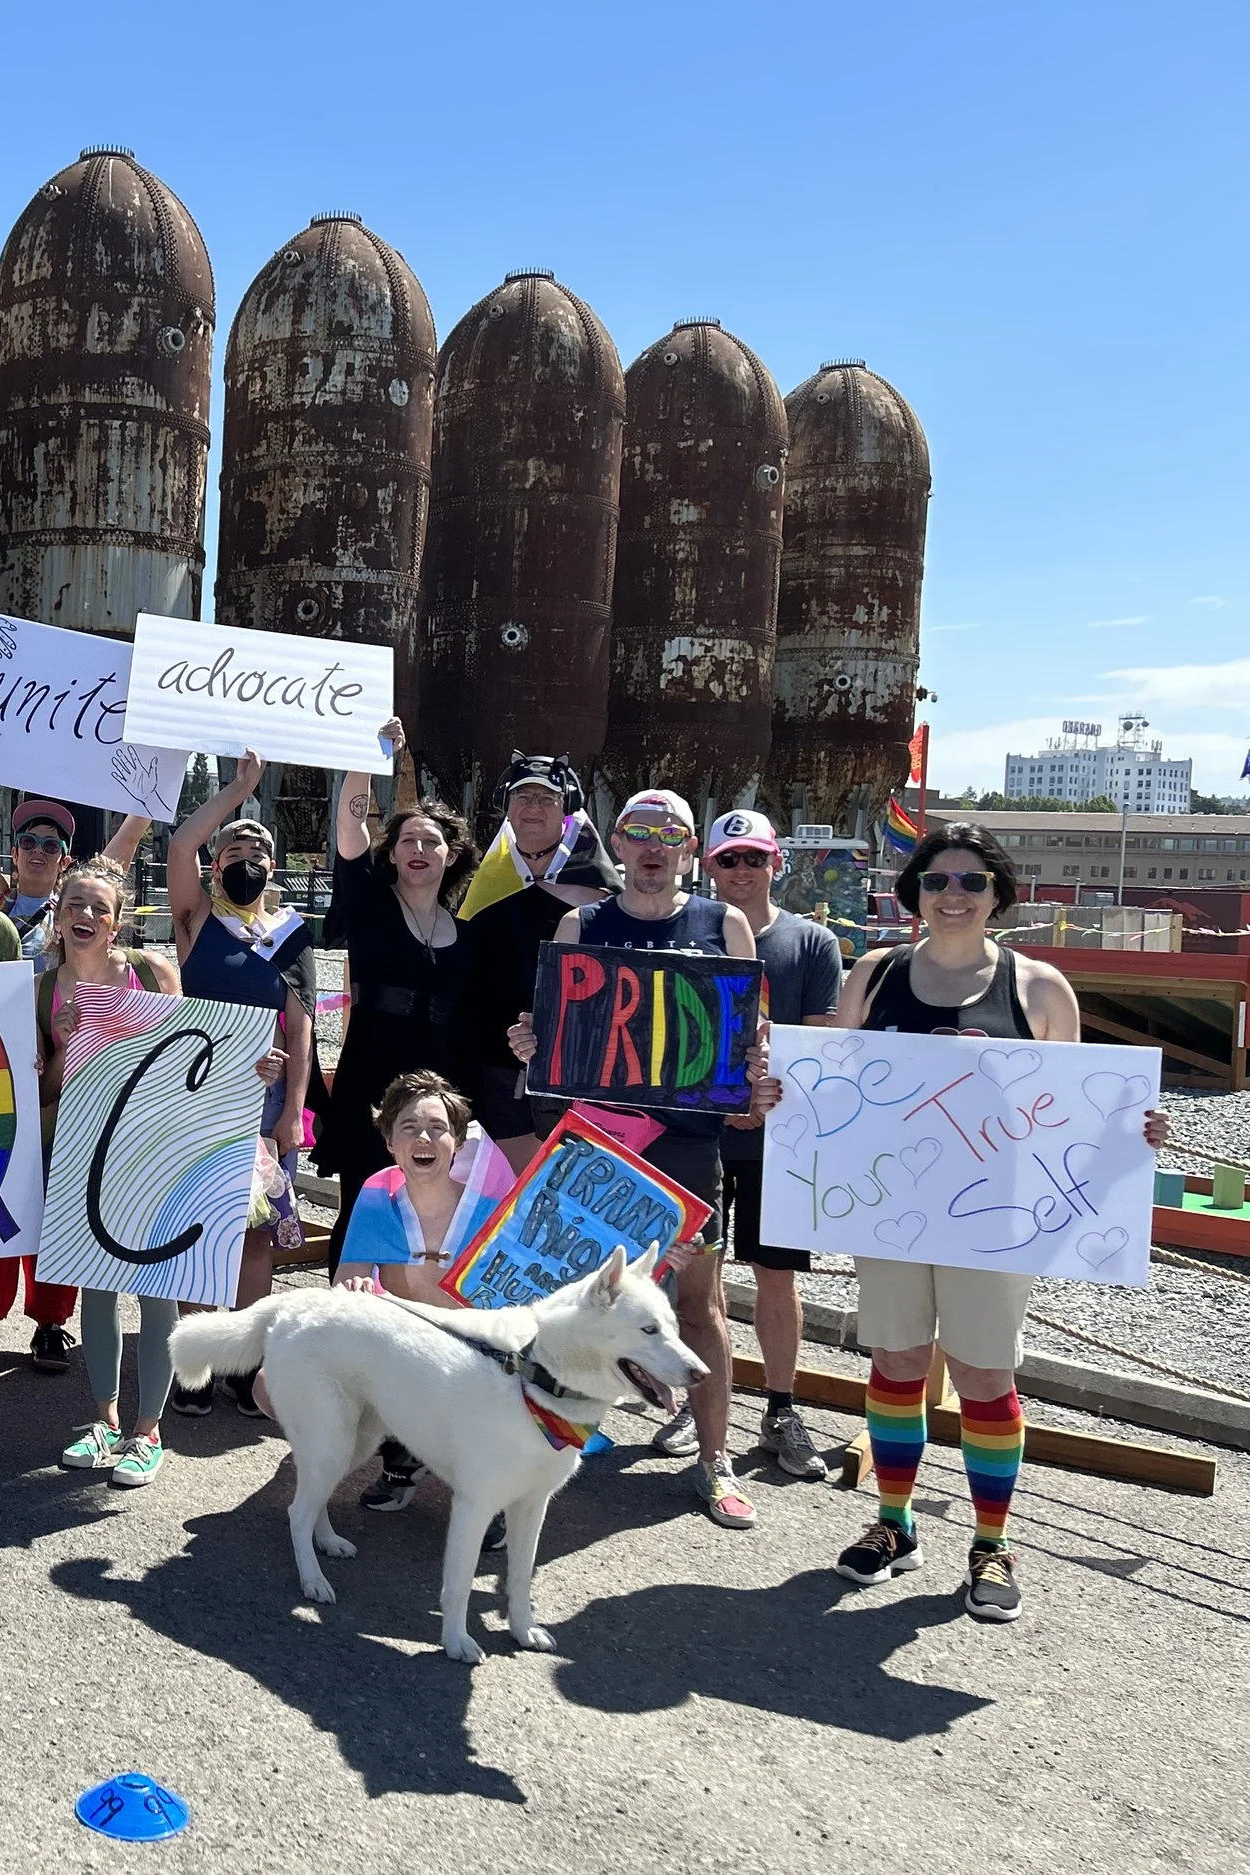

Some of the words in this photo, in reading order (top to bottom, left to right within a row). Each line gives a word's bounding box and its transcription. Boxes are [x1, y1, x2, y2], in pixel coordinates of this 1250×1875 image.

[157, 646, 363, 717] advocate
[547, 952, 754, 1088] PRIDE
[86, 1027, 233, 1266] C
[786, 1057, 925, 1138] Be
[902, 1071, 1070, 1163] True
[546, 1129, 680, 1250] TRANS
[785, 1149, 895, 1232] Your
[947, 1141, 1102, 1253] Self
